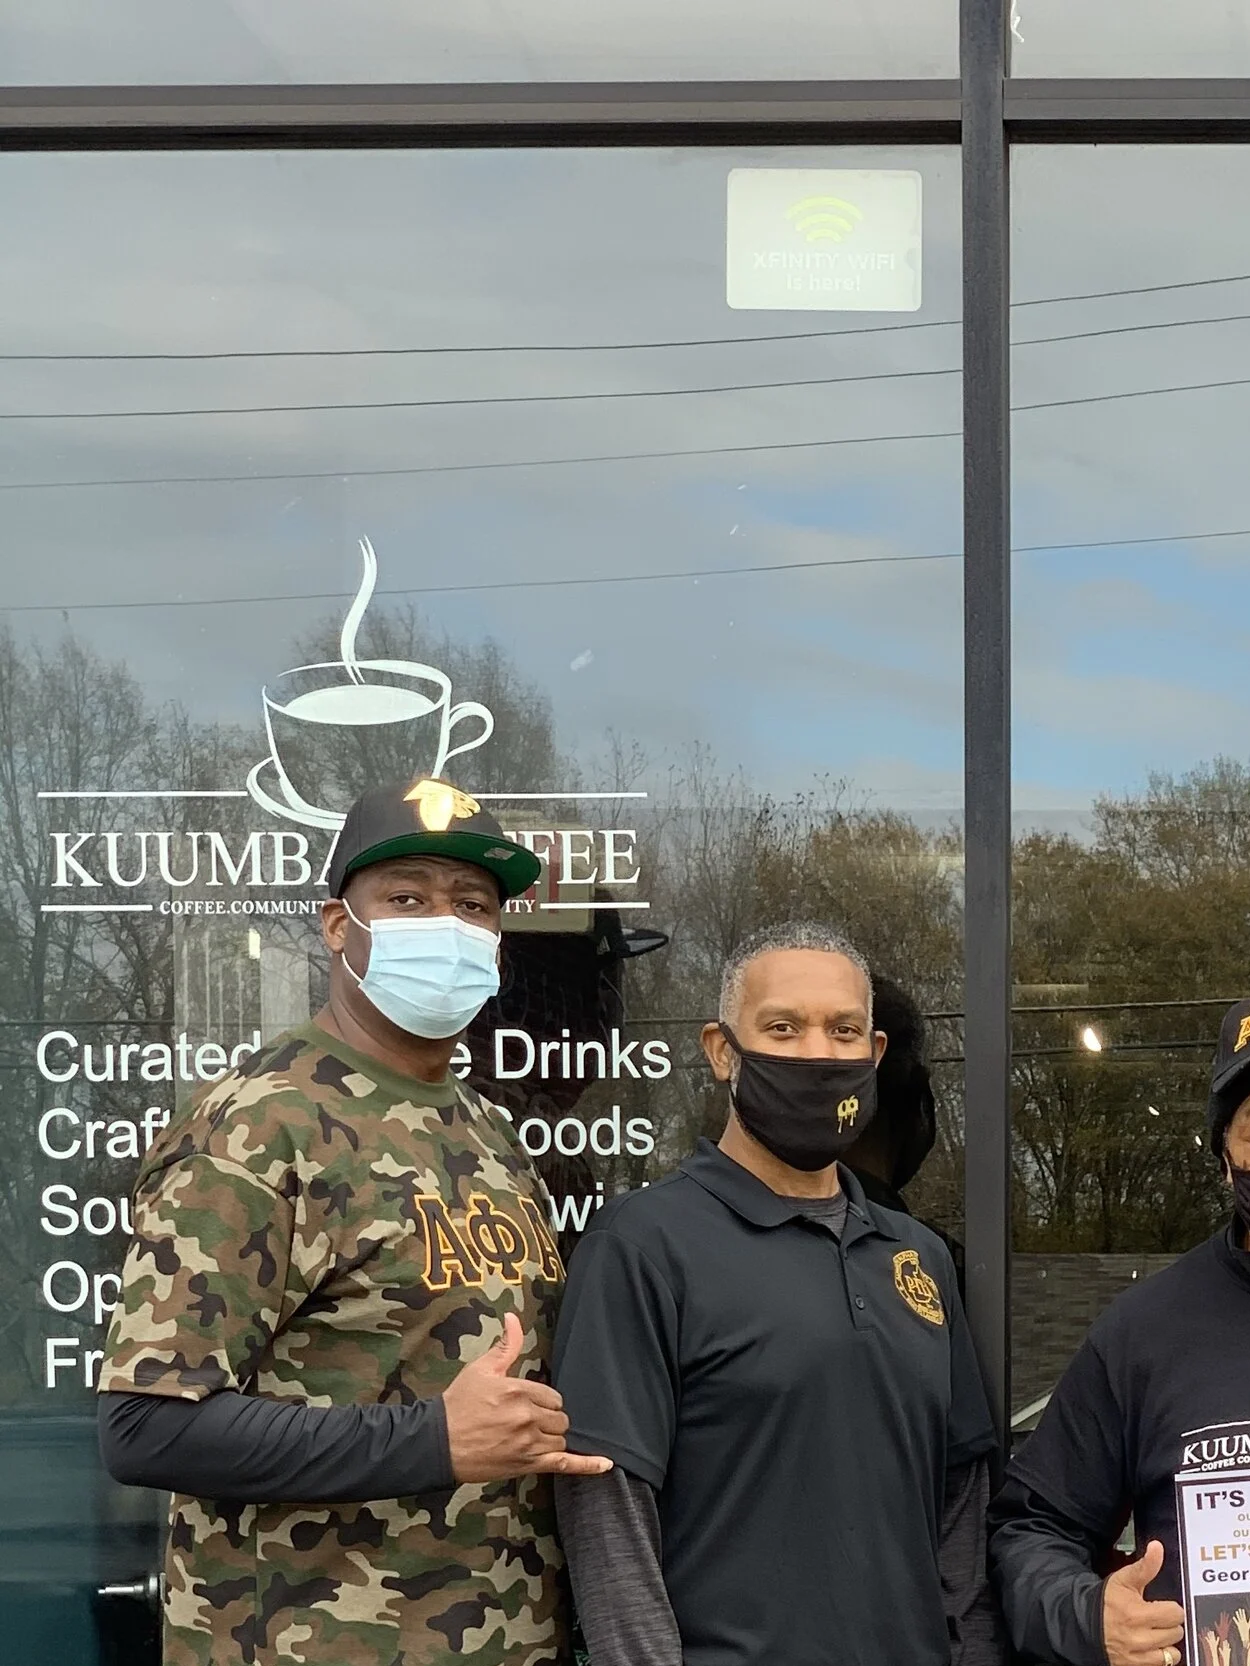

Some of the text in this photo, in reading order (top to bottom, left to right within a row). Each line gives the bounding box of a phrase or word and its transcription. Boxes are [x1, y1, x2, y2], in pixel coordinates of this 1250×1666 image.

[752, 251, 840, 271] XFINITY
[50, 831, 340, 887] KUUMB
[494, 1028, 672, 1080] Drinks
[495, 1105, 655, 1157] oods
[1201, 1458, 1235, 1472] COFFEE
[1195, 1489, 1245, 1511] IT'S
